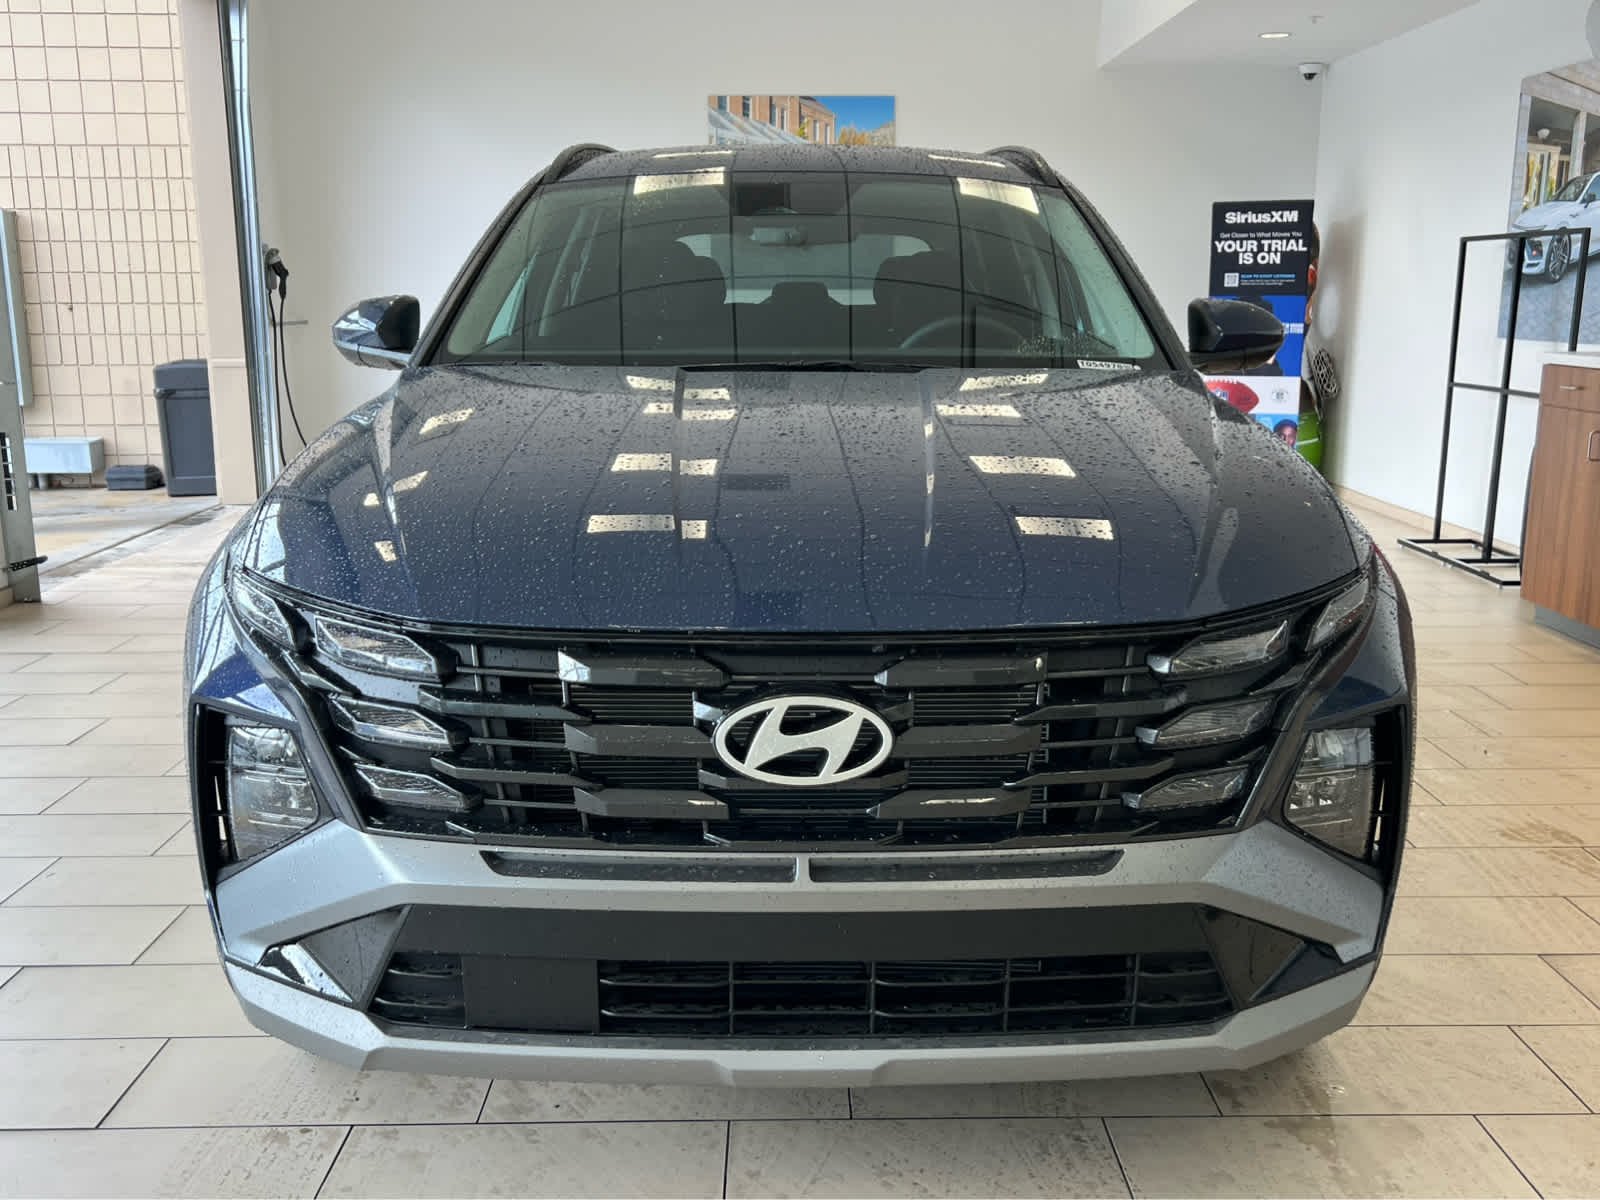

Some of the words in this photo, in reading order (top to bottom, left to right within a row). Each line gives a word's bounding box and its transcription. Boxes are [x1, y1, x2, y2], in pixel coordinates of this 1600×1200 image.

[1225, 210, 1298, 224] SiriusXM
[1215, 240, 1258, 253] YOUR
[1261, 239, 1307, 252] TRIAL
[1238, 252, 1254, 265] IS
[1257, 252, 1281, 265] ON
